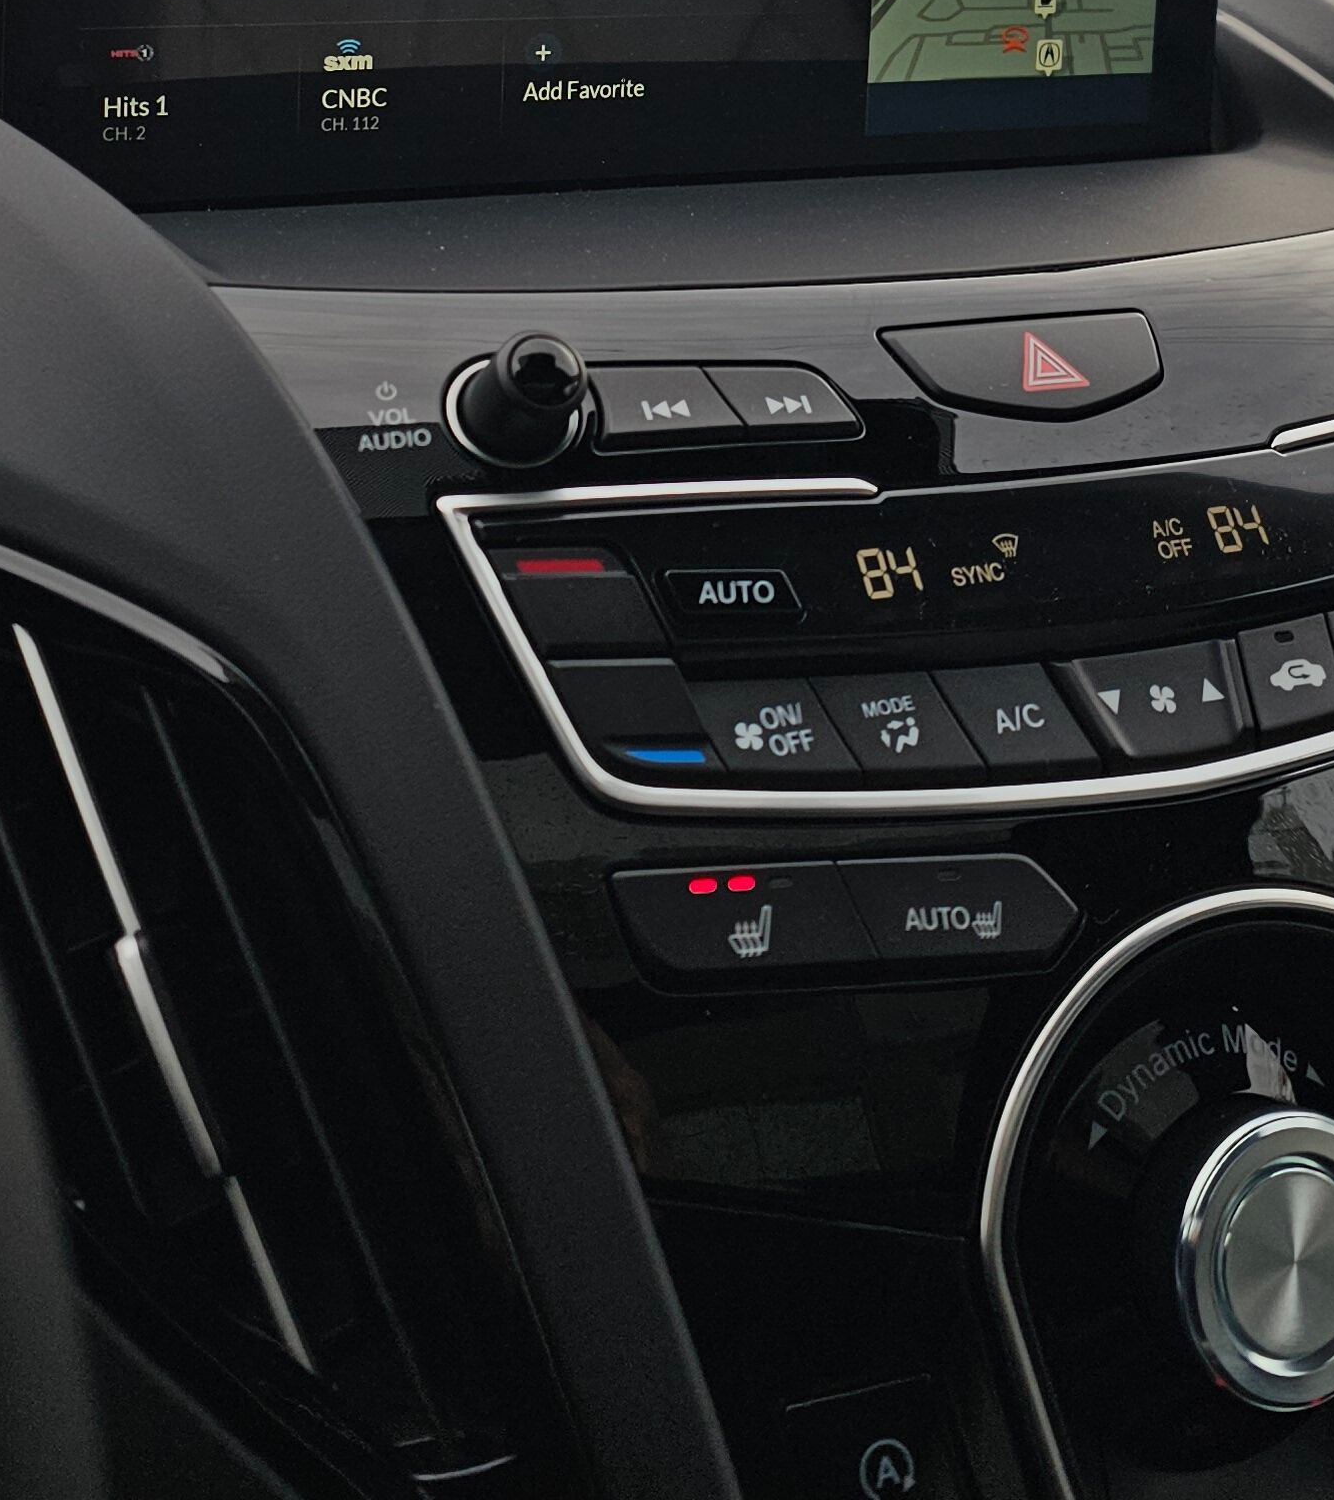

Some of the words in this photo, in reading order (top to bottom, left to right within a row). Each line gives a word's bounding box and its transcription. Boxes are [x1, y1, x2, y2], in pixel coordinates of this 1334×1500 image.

[322, 87, 387, 109] CNBC
[523, 81, 562, 102] Add
[567, 79, 645, 100] Favorite
[103, 97, 149, 118] Hits
[156, 95, 168, 116] 1
[102, 127, 132, 142] CH.
[136, 125, 146, 140] 2
[321, 117, 348, 132] CH.
[353, 116, 380, 131] 112
[368, 408, 415, 427] VOL
[358, 428, 432, 452] AUDIO
[1153, 518, 1184, 538] A/C
[1207, 504, 1269, 553] 84
[1158, 538, 1193, 559] OFF
[856, 547, 923, 600] 84
[951, 562, 1005, 587] SYNC
[699, 580, 774, 605] AUTO
[759, 705, 802, 730] ON/
[862, 696, 915, 718] MODE
[995, 703, 1045, 734] A/C
[769, 729, 814, 755] OFF
[905, 908, 969, 931] AUTO
[1098, 1028, 1215, 1121] Dynamic
[1222, 1023, 1298, 1072] Mode
